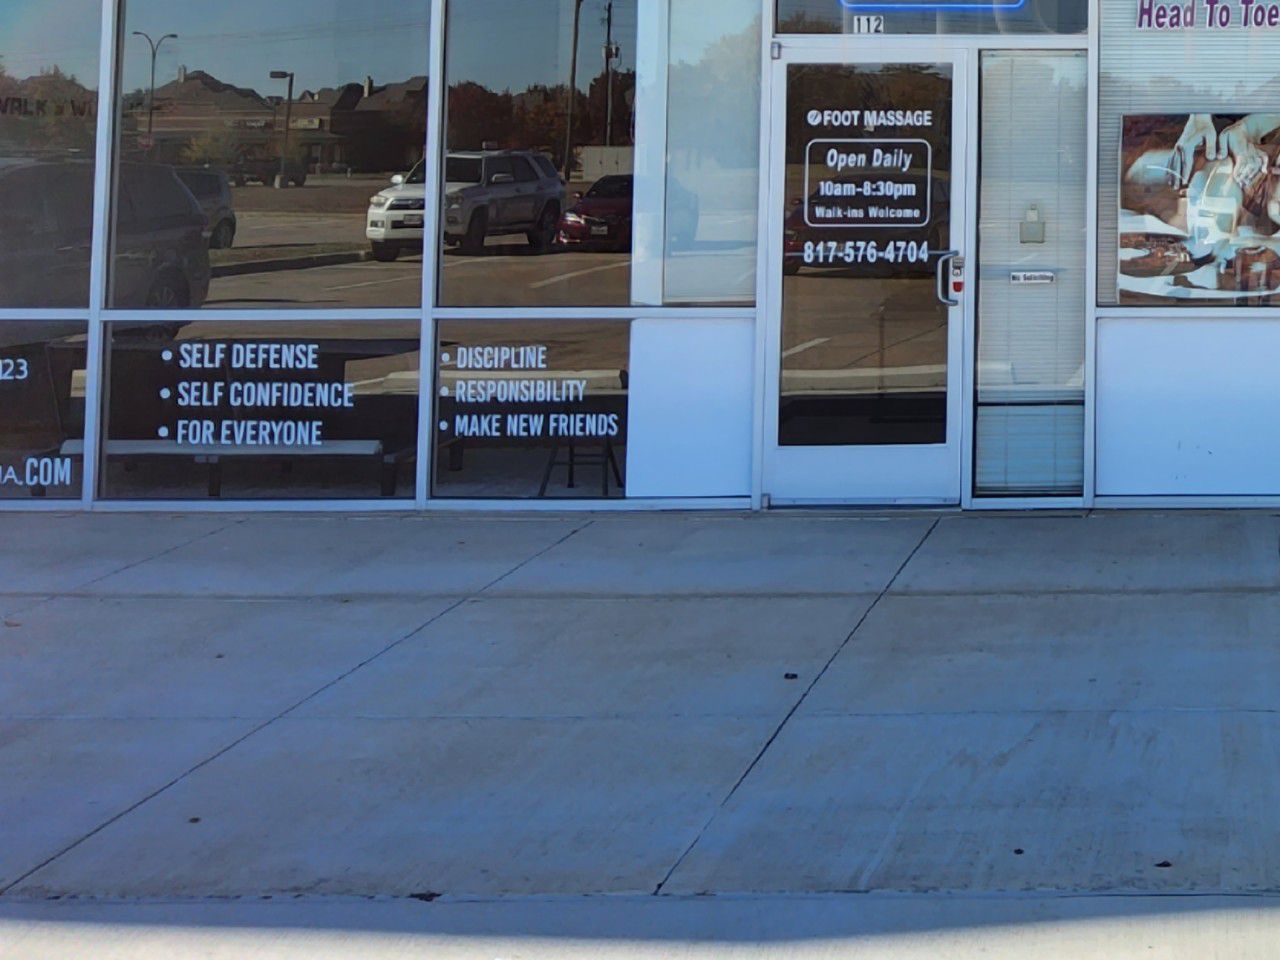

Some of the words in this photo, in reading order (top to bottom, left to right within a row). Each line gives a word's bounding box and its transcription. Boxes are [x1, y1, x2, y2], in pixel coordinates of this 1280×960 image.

[855, 16, 884, 33] 112
[823, 110, 860, 127] FOOT
[863, 110, 933, 127] MASSAGE
[826, 148, 866, 172] Open
[872, 148, 913, 172] Daily
[818, 180, 917, 200] 10am-8:30pm
[815, 206, 865, 219] Walk-ins
[868, 206, 921, 219] Welcome
[803, 241, 929, 264] 817-576-4704
[178, 343, 227, 369] SELF
[231, 343, 319, 369] DEFENSE
[456, 345, 548, 369] DISCIPLINE
[177, 381, 225, 407] SELF
[229, 382, 355, 407] CONFIDENCE
[455, 379, 587, 403] RESPONSIBILITY
[176, 420, 215, 445] FOR
[220, 420, 323, 446] EVERYONE
[454, 413, 501, 437] MAKE
[506, 413, 544, 437] NEW
[549, 412, 619, 437] FRIENDS
